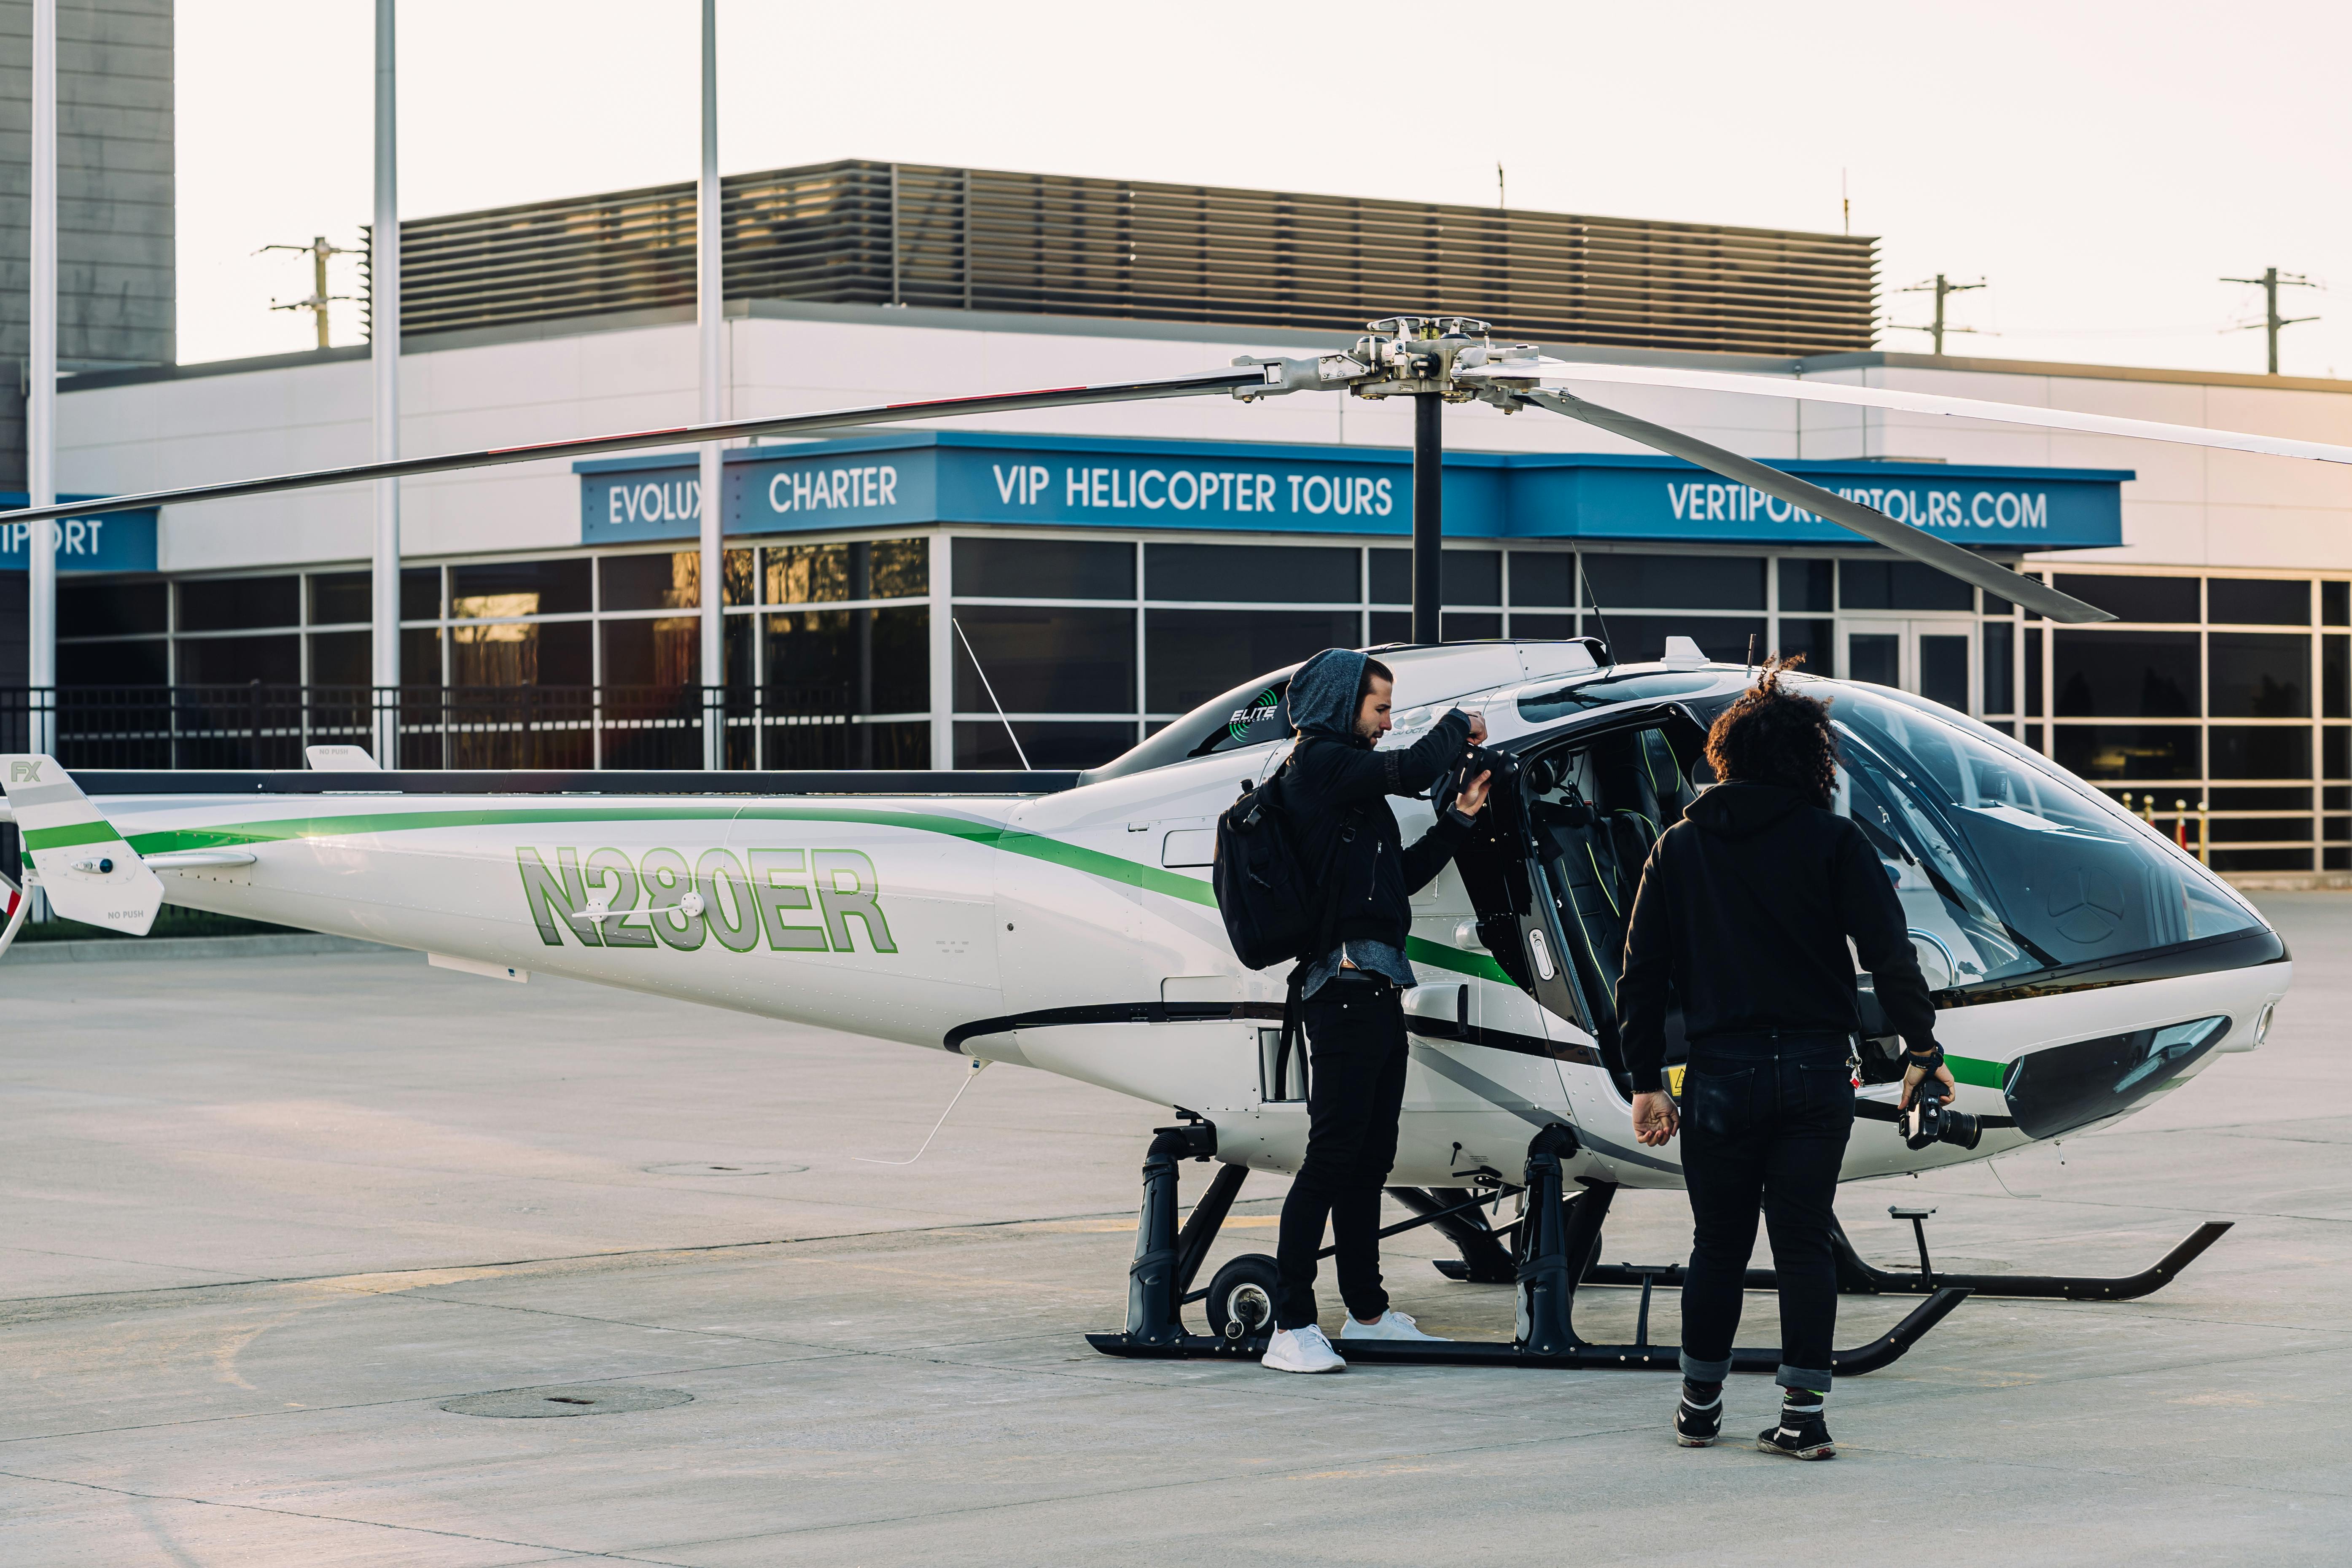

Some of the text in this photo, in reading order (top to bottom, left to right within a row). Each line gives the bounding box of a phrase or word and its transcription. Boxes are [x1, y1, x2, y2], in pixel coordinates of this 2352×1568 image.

[769, 465, 897, 513] CHARTER
[993, 465, 1393, 516] VIP HELICOPTER TOURS
[1667, 483, 2047, 528] VERTIPOPTOURS.COM
[2, 519, 102, 555] IPRT
[1229, 716, 1274, 725] ROTORCRAFT
[1230, 705, 1278, 721] ELITE
[11, 761, 43, 783] FX
[108, 910, 144, 920] NO PUSH
[515, 846, 899, 955] N280ER
